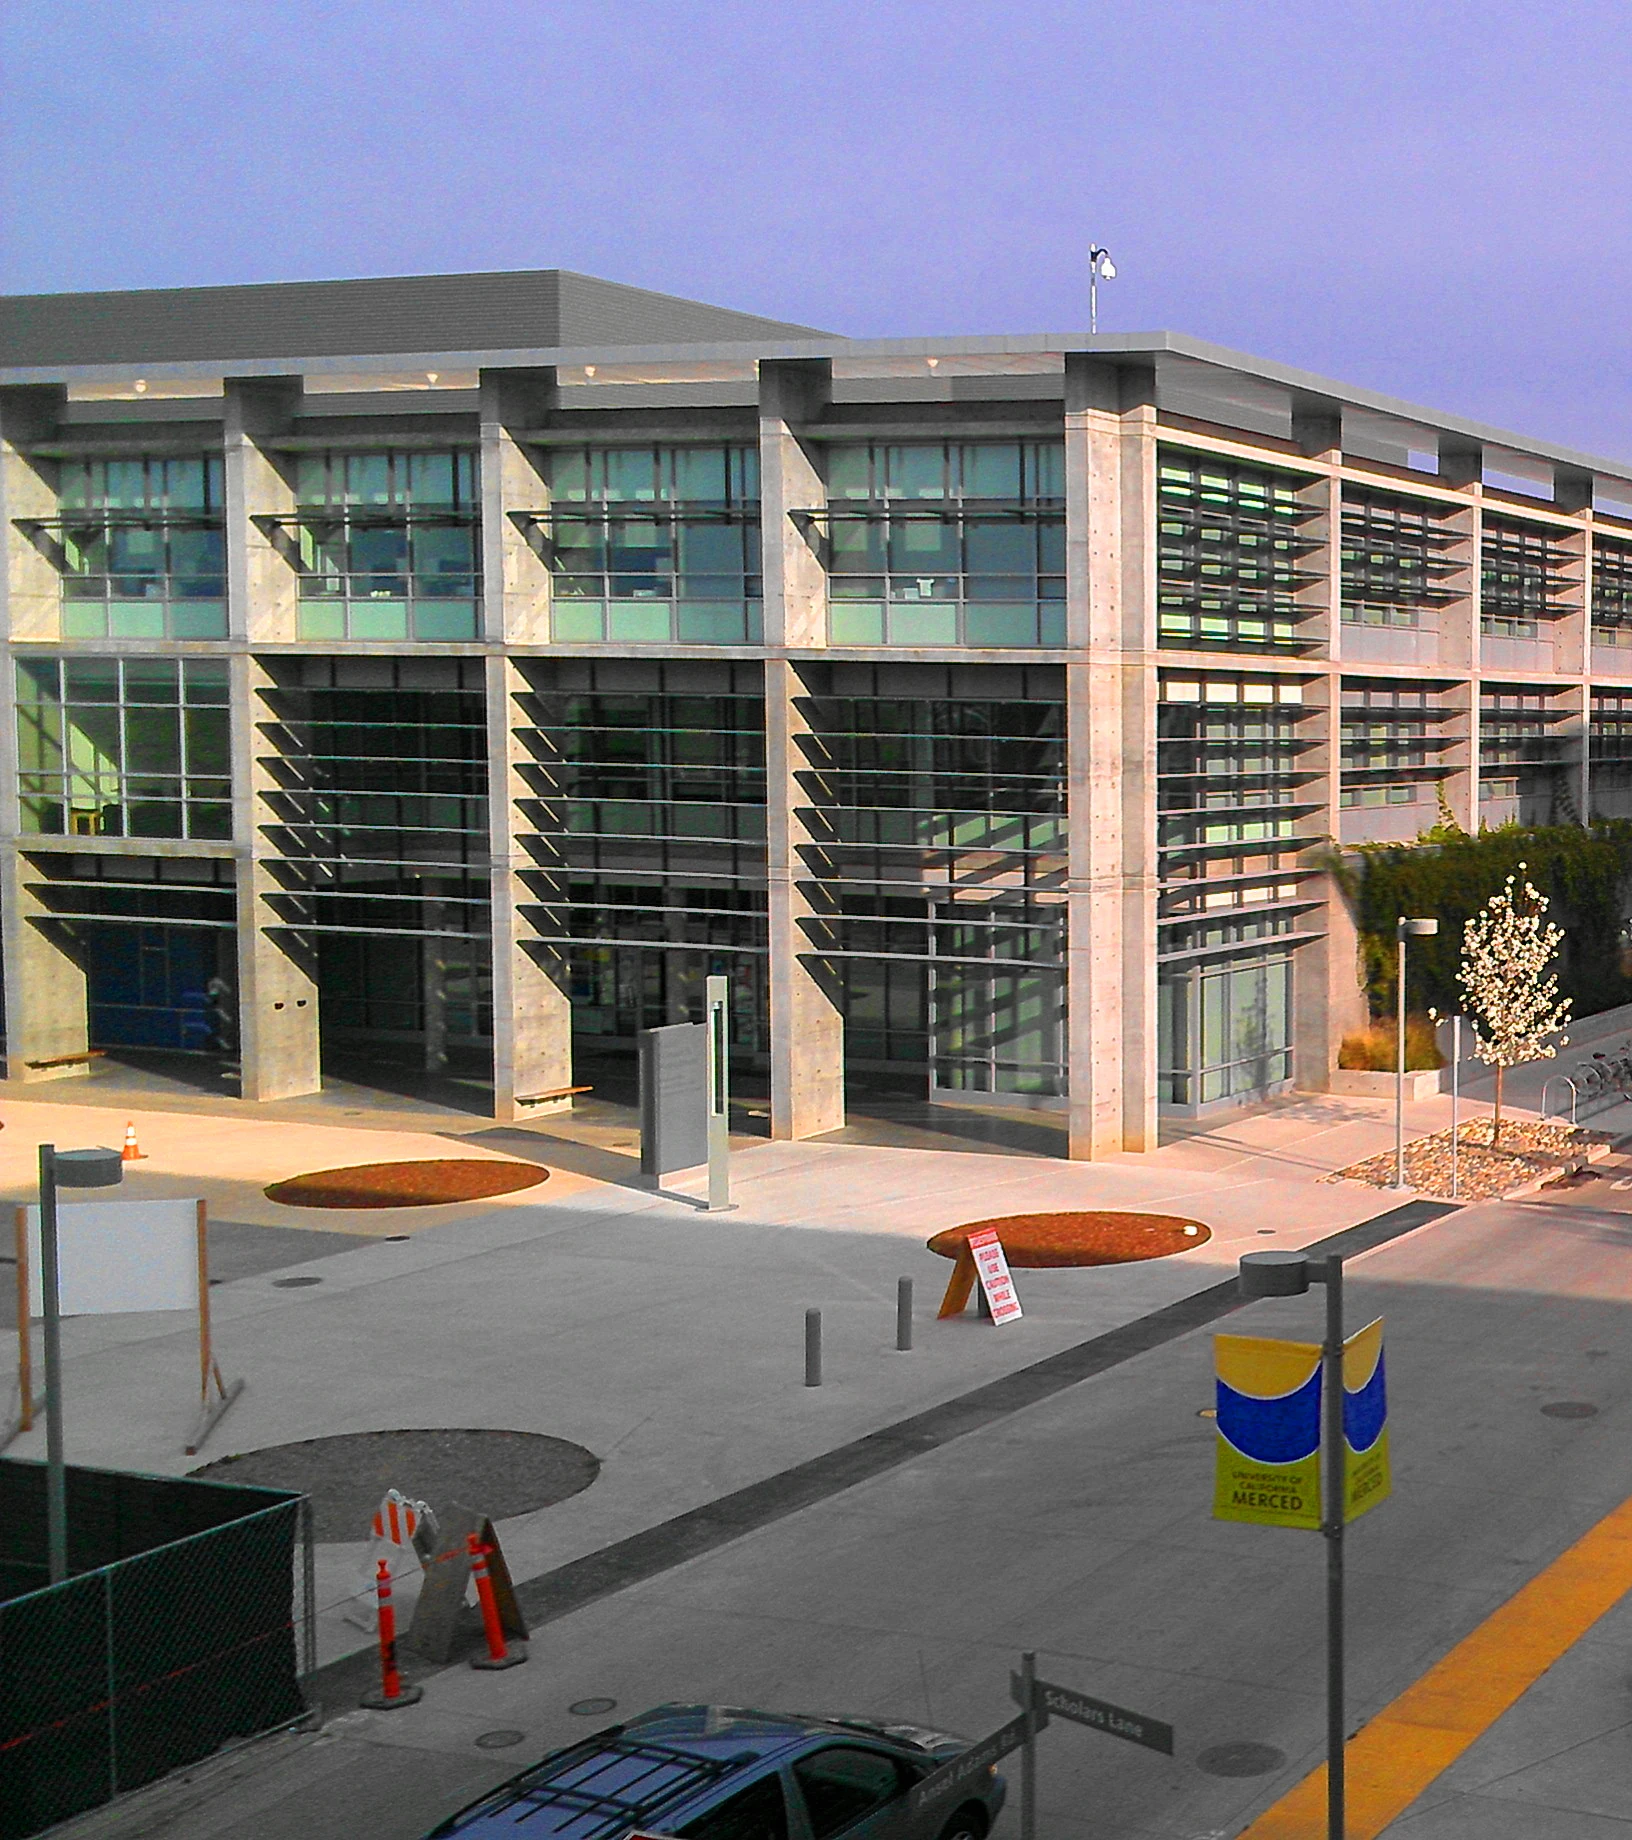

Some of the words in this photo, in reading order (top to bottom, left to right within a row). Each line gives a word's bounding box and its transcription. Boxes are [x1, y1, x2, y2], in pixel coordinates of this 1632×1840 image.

[1231, 1471, 1288, 1482] UNIVERSITY
[1289, 1475, 1303, 1485] OF
[1239, 1480, 1298, 1494] CALIFORNIA
[1231, 1490, 1303, 1511] MERCED
[1044, 1689, 1105, 1724] Scholars
[1108, 1711, 1143, 1738] Lane
